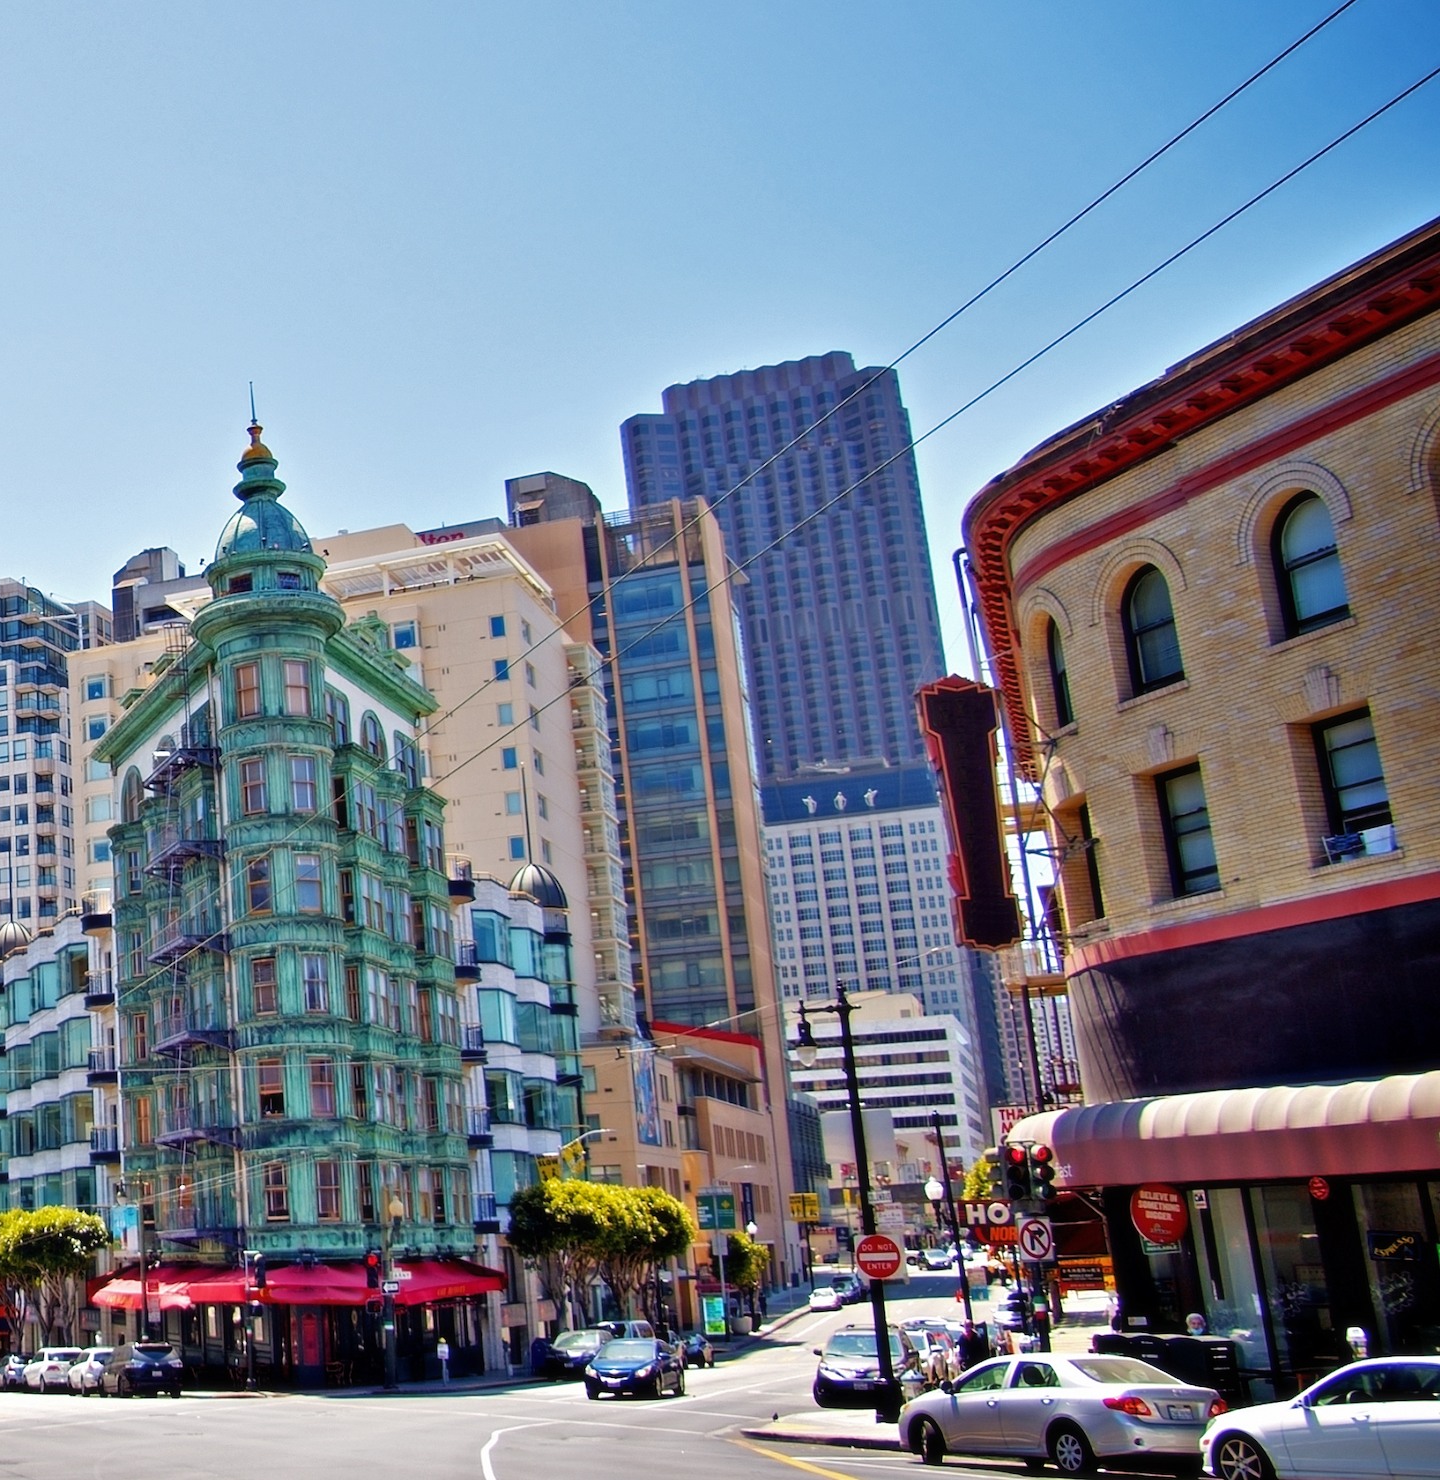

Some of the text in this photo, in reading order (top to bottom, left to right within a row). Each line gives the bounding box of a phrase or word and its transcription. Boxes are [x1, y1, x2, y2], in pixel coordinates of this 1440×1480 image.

[420, 533, 464, 544] lton
[965, 1202, 1011, 1225] HO
[861, 1243, 893, 1252] DO NOT
[1374, 1235, 1415, 1256] ESPRESSO
